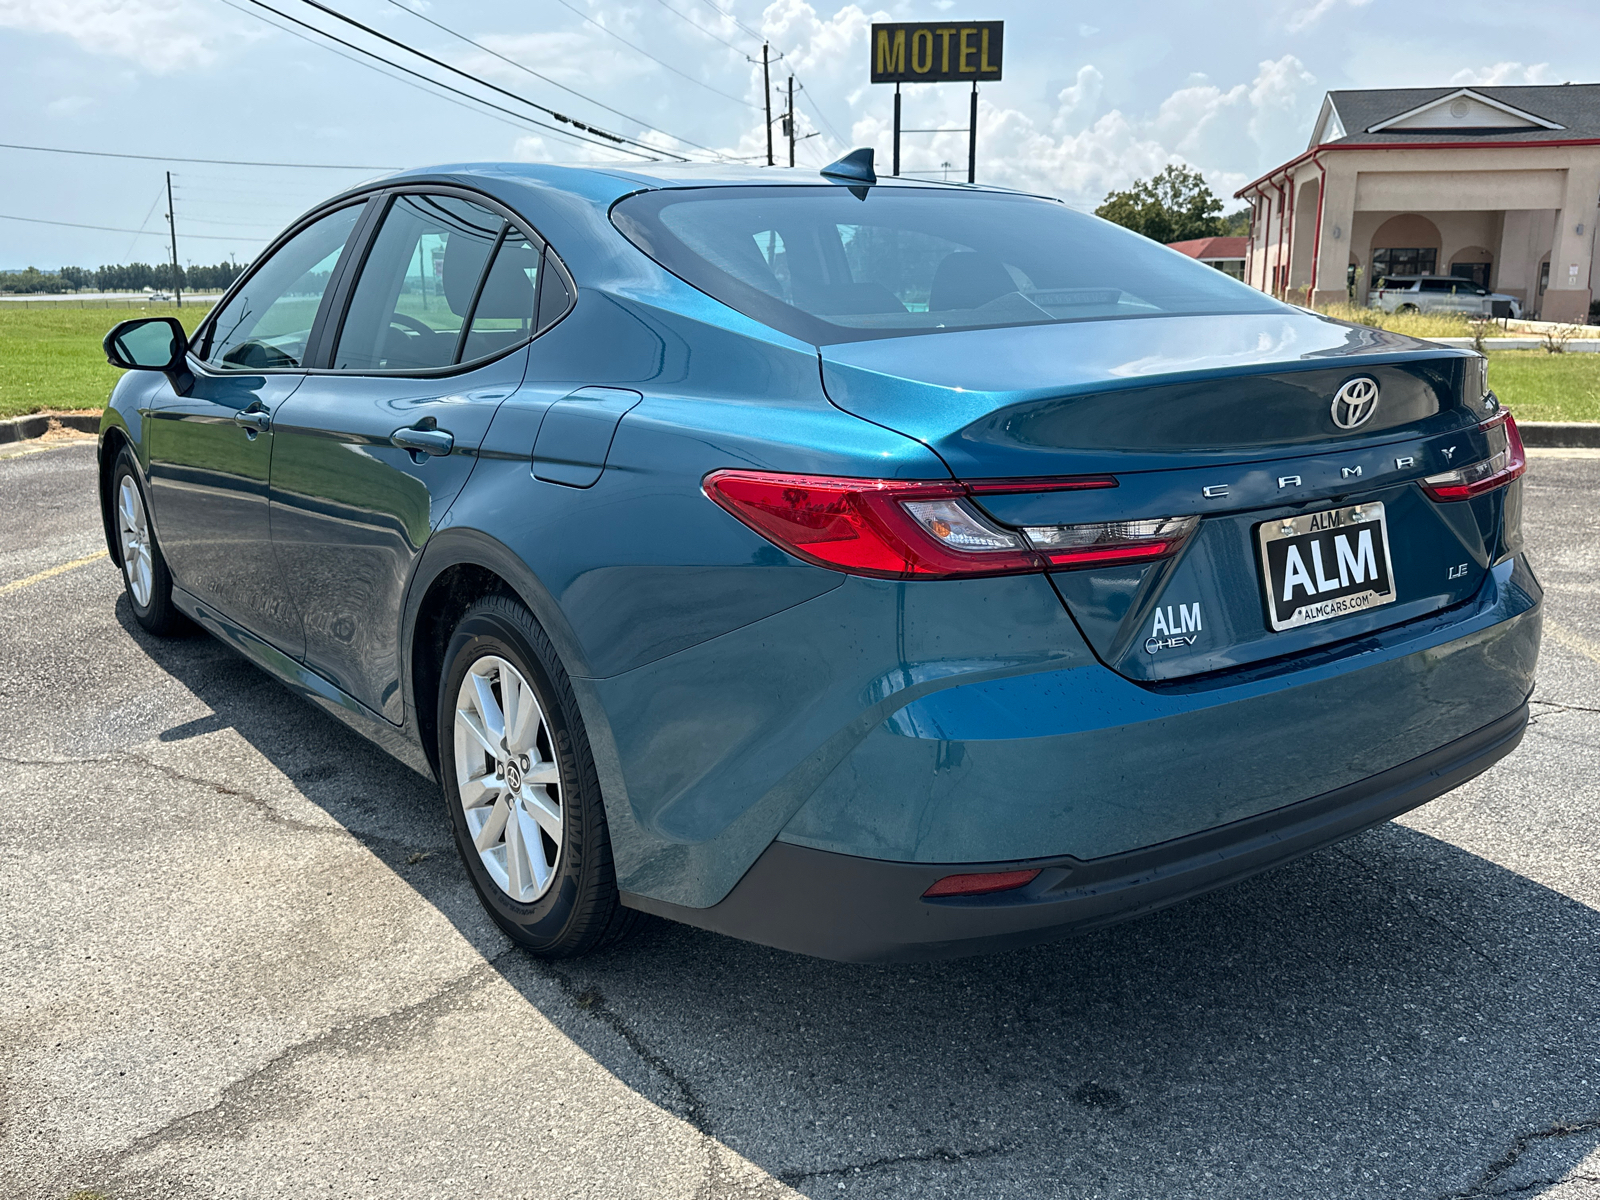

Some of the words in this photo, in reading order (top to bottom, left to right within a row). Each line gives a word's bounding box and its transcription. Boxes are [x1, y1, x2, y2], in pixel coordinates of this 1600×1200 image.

[877, 28, 998, 74] MOTEL
[1203, 446, 1456, 498] CAMRY
[1310, 510, 1340, 531] ALM
[1283, 529, 1378, 601] ALM
[1449, 563, 1468, 580] LE
[1152, 602, 1202, 637] ALM
[1304, 595, 1369, 620] ALMCARS.COM
[556, 729, 583, 886] OMNIMAX
